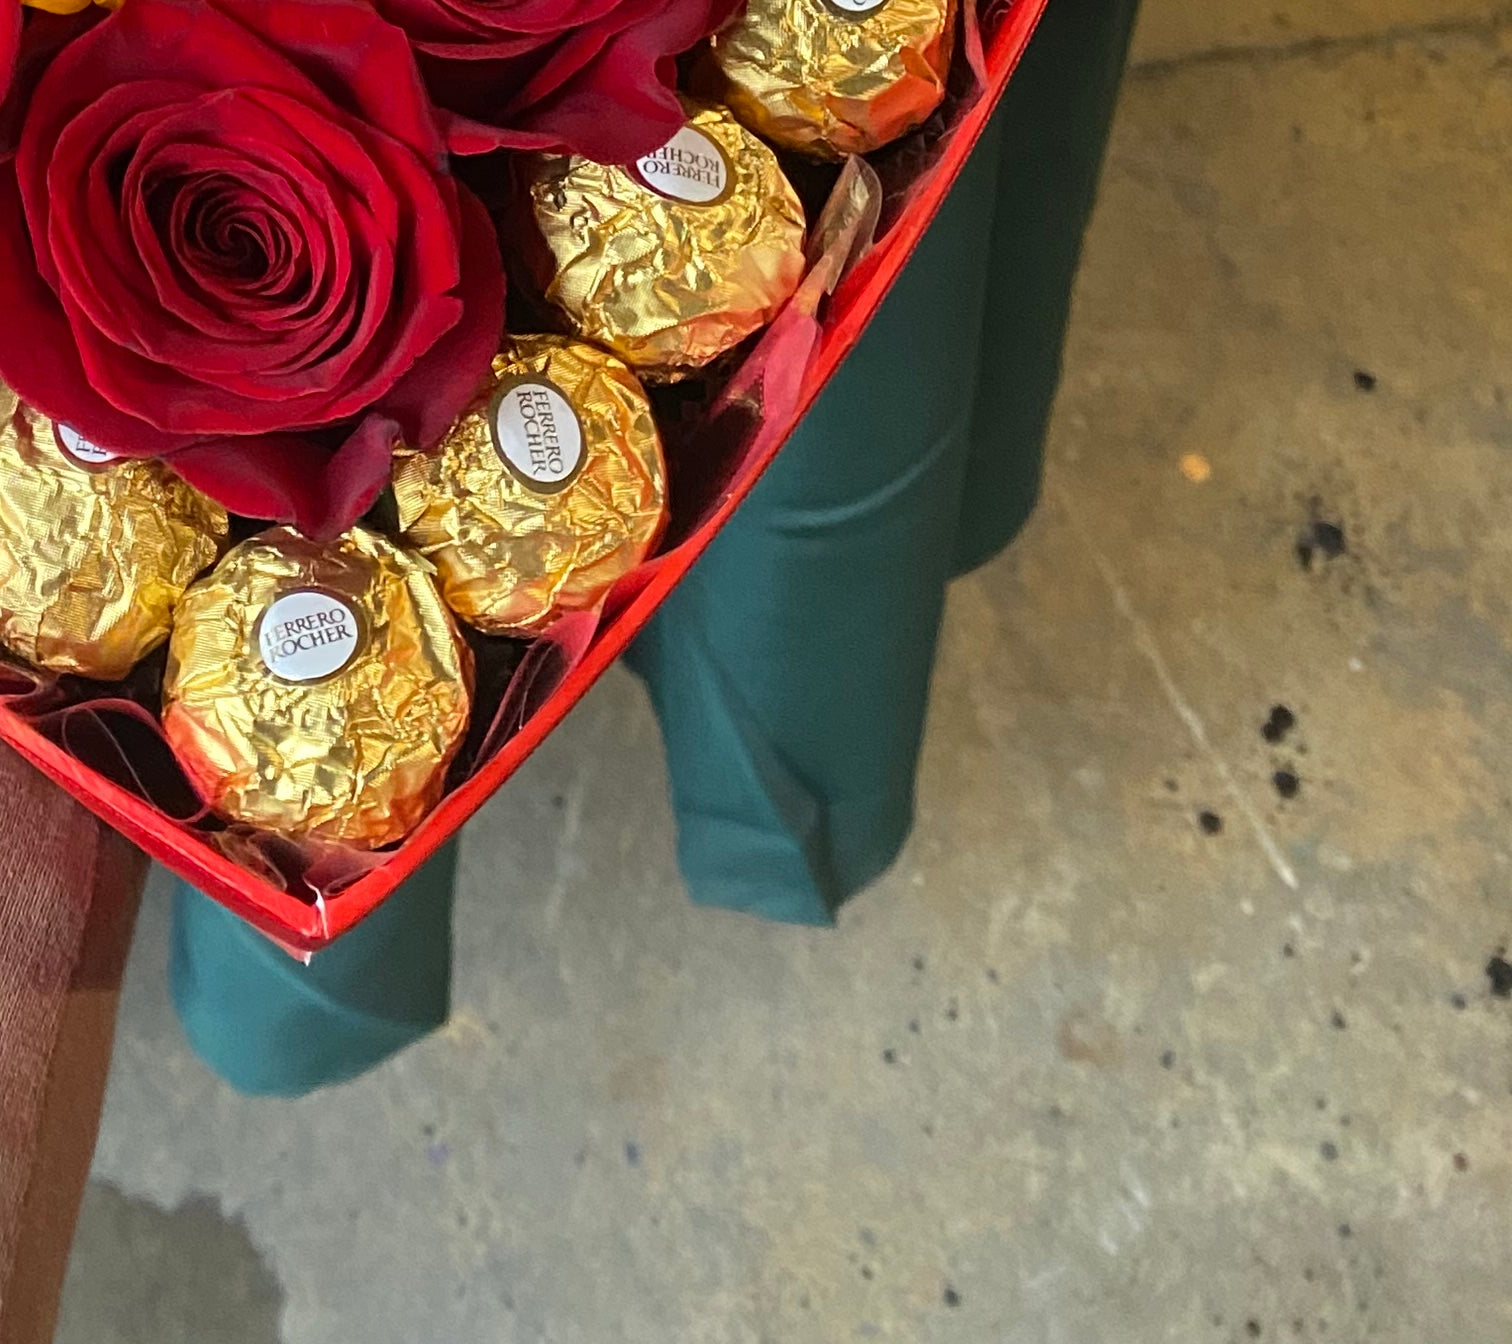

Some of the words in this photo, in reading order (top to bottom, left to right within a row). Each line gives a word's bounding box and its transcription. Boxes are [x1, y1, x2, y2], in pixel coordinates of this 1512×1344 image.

[643, 160, 720, 189] FERRERO
[517, 392, 546, 475] ROCHER
[532, 391, 564, 474] FERRERO
[264, 608, 346, 647] FERRERO
[269, 624, 354, 663] ROCHER
